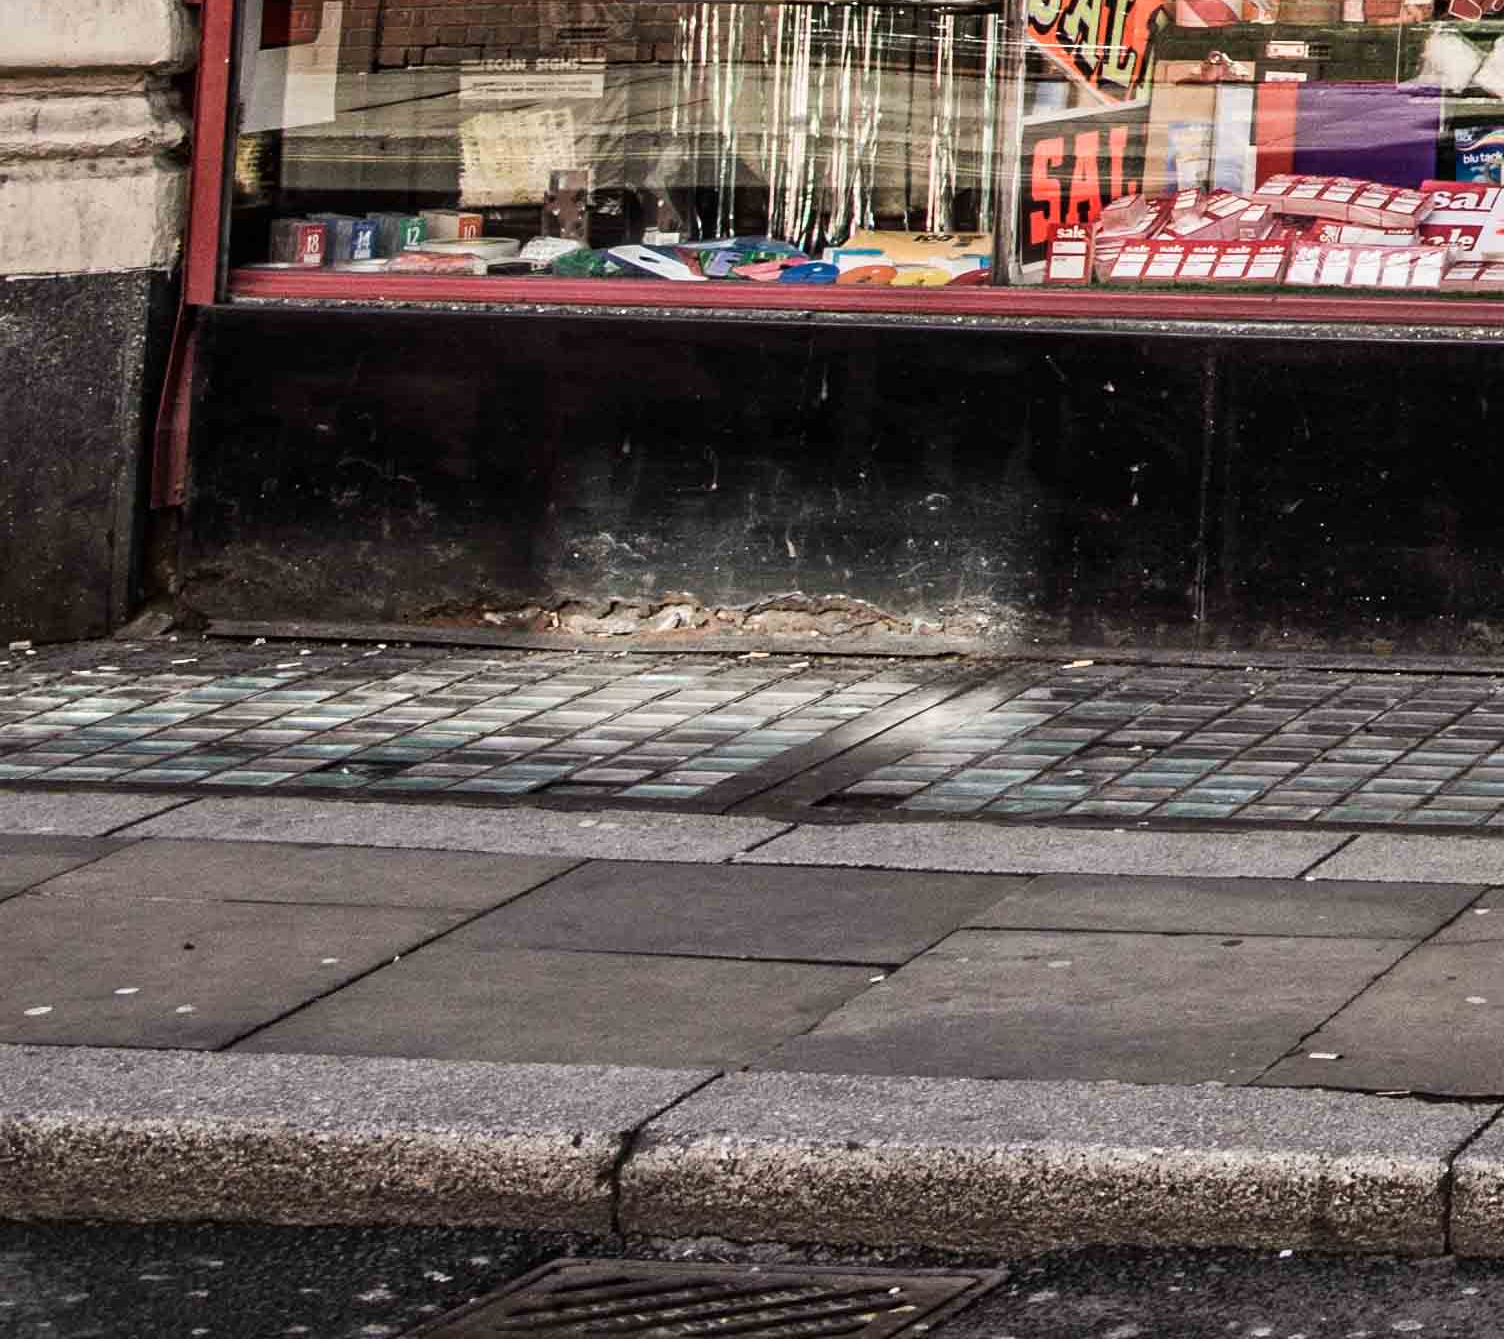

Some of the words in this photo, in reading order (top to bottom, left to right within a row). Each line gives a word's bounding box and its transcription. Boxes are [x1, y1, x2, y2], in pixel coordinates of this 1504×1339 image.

[1463, 152, 1481, 165] blu
[1029, 125, 1137, 245] SAL
[1432, 189, 1501, 211] sal
[406, 226, 420, 247] 12
[1056, 225, 1087, 239] sale
[1421, 227, 1476, 252] ale
[303, 235, 320, 254] 18
